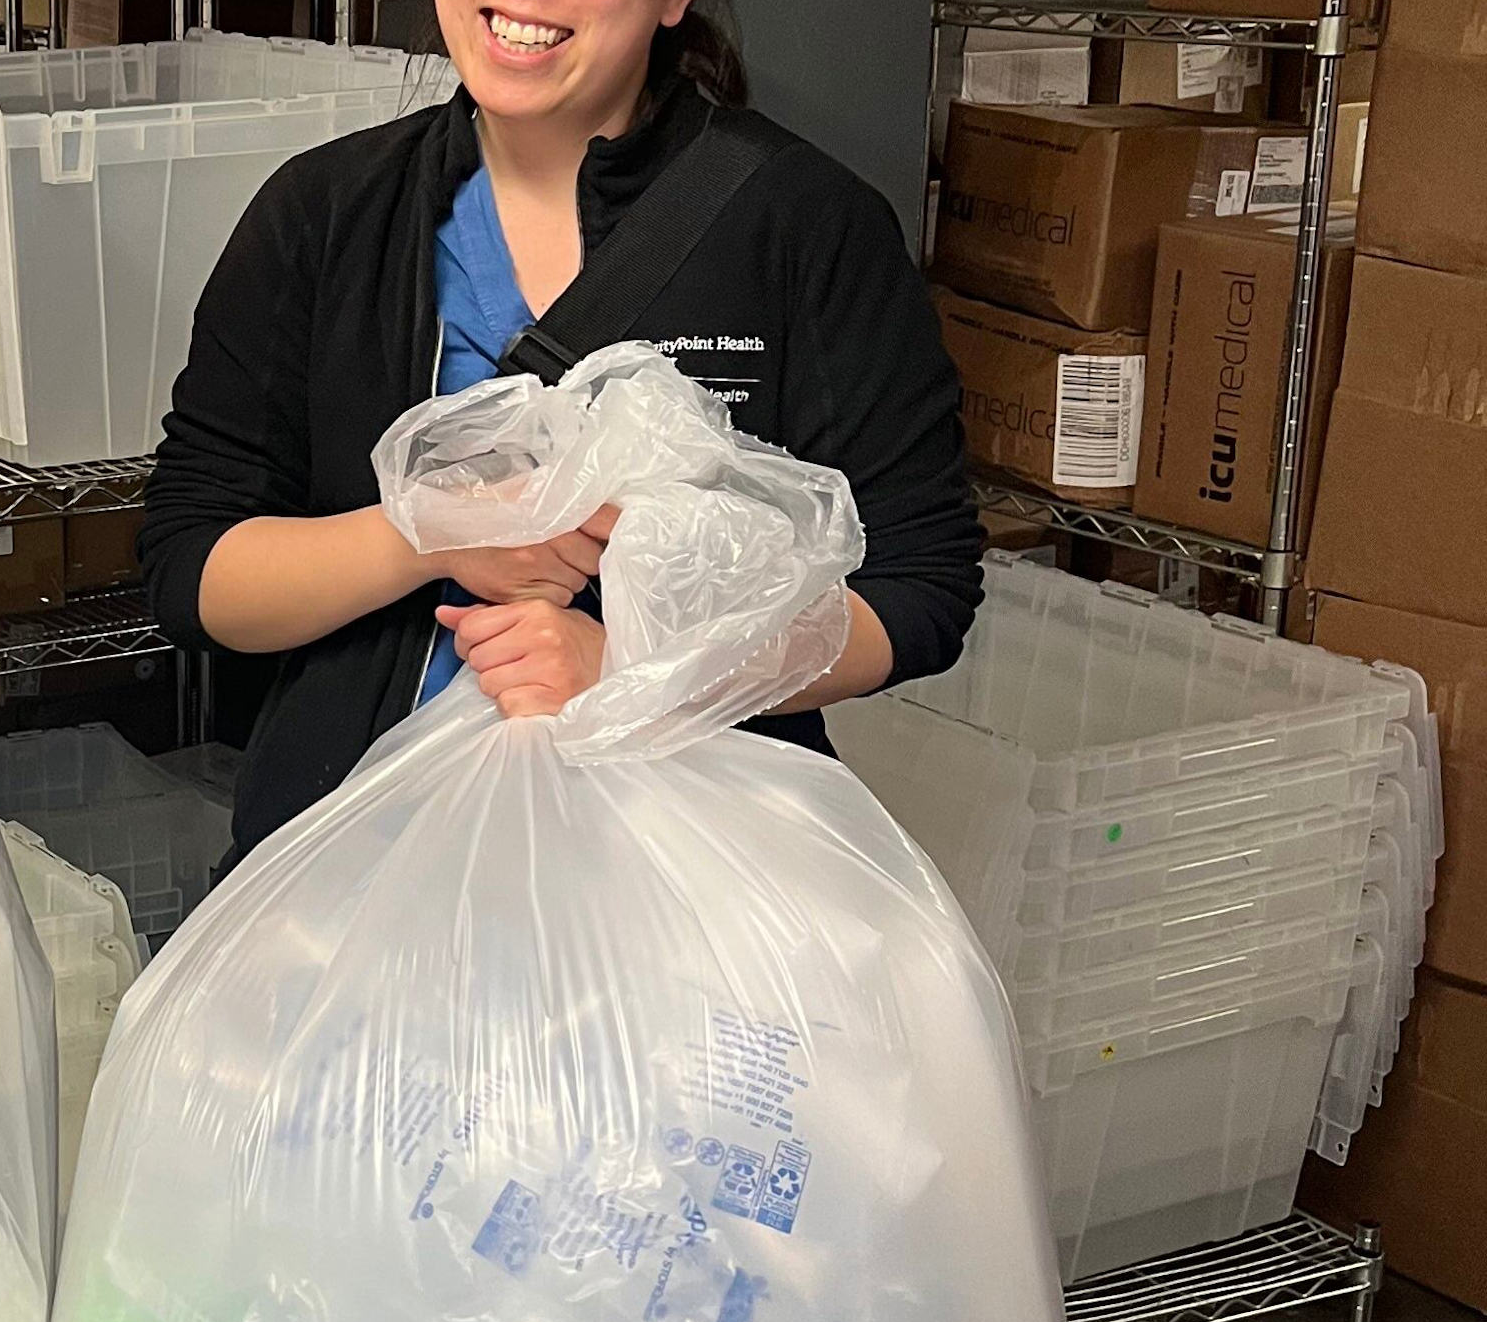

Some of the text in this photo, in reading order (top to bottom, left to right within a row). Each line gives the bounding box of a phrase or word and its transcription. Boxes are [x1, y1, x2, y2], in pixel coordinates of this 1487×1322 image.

[654, 335, 765, 354] nityPoint Health
[1199, 270, 1257, 503] icumedical
